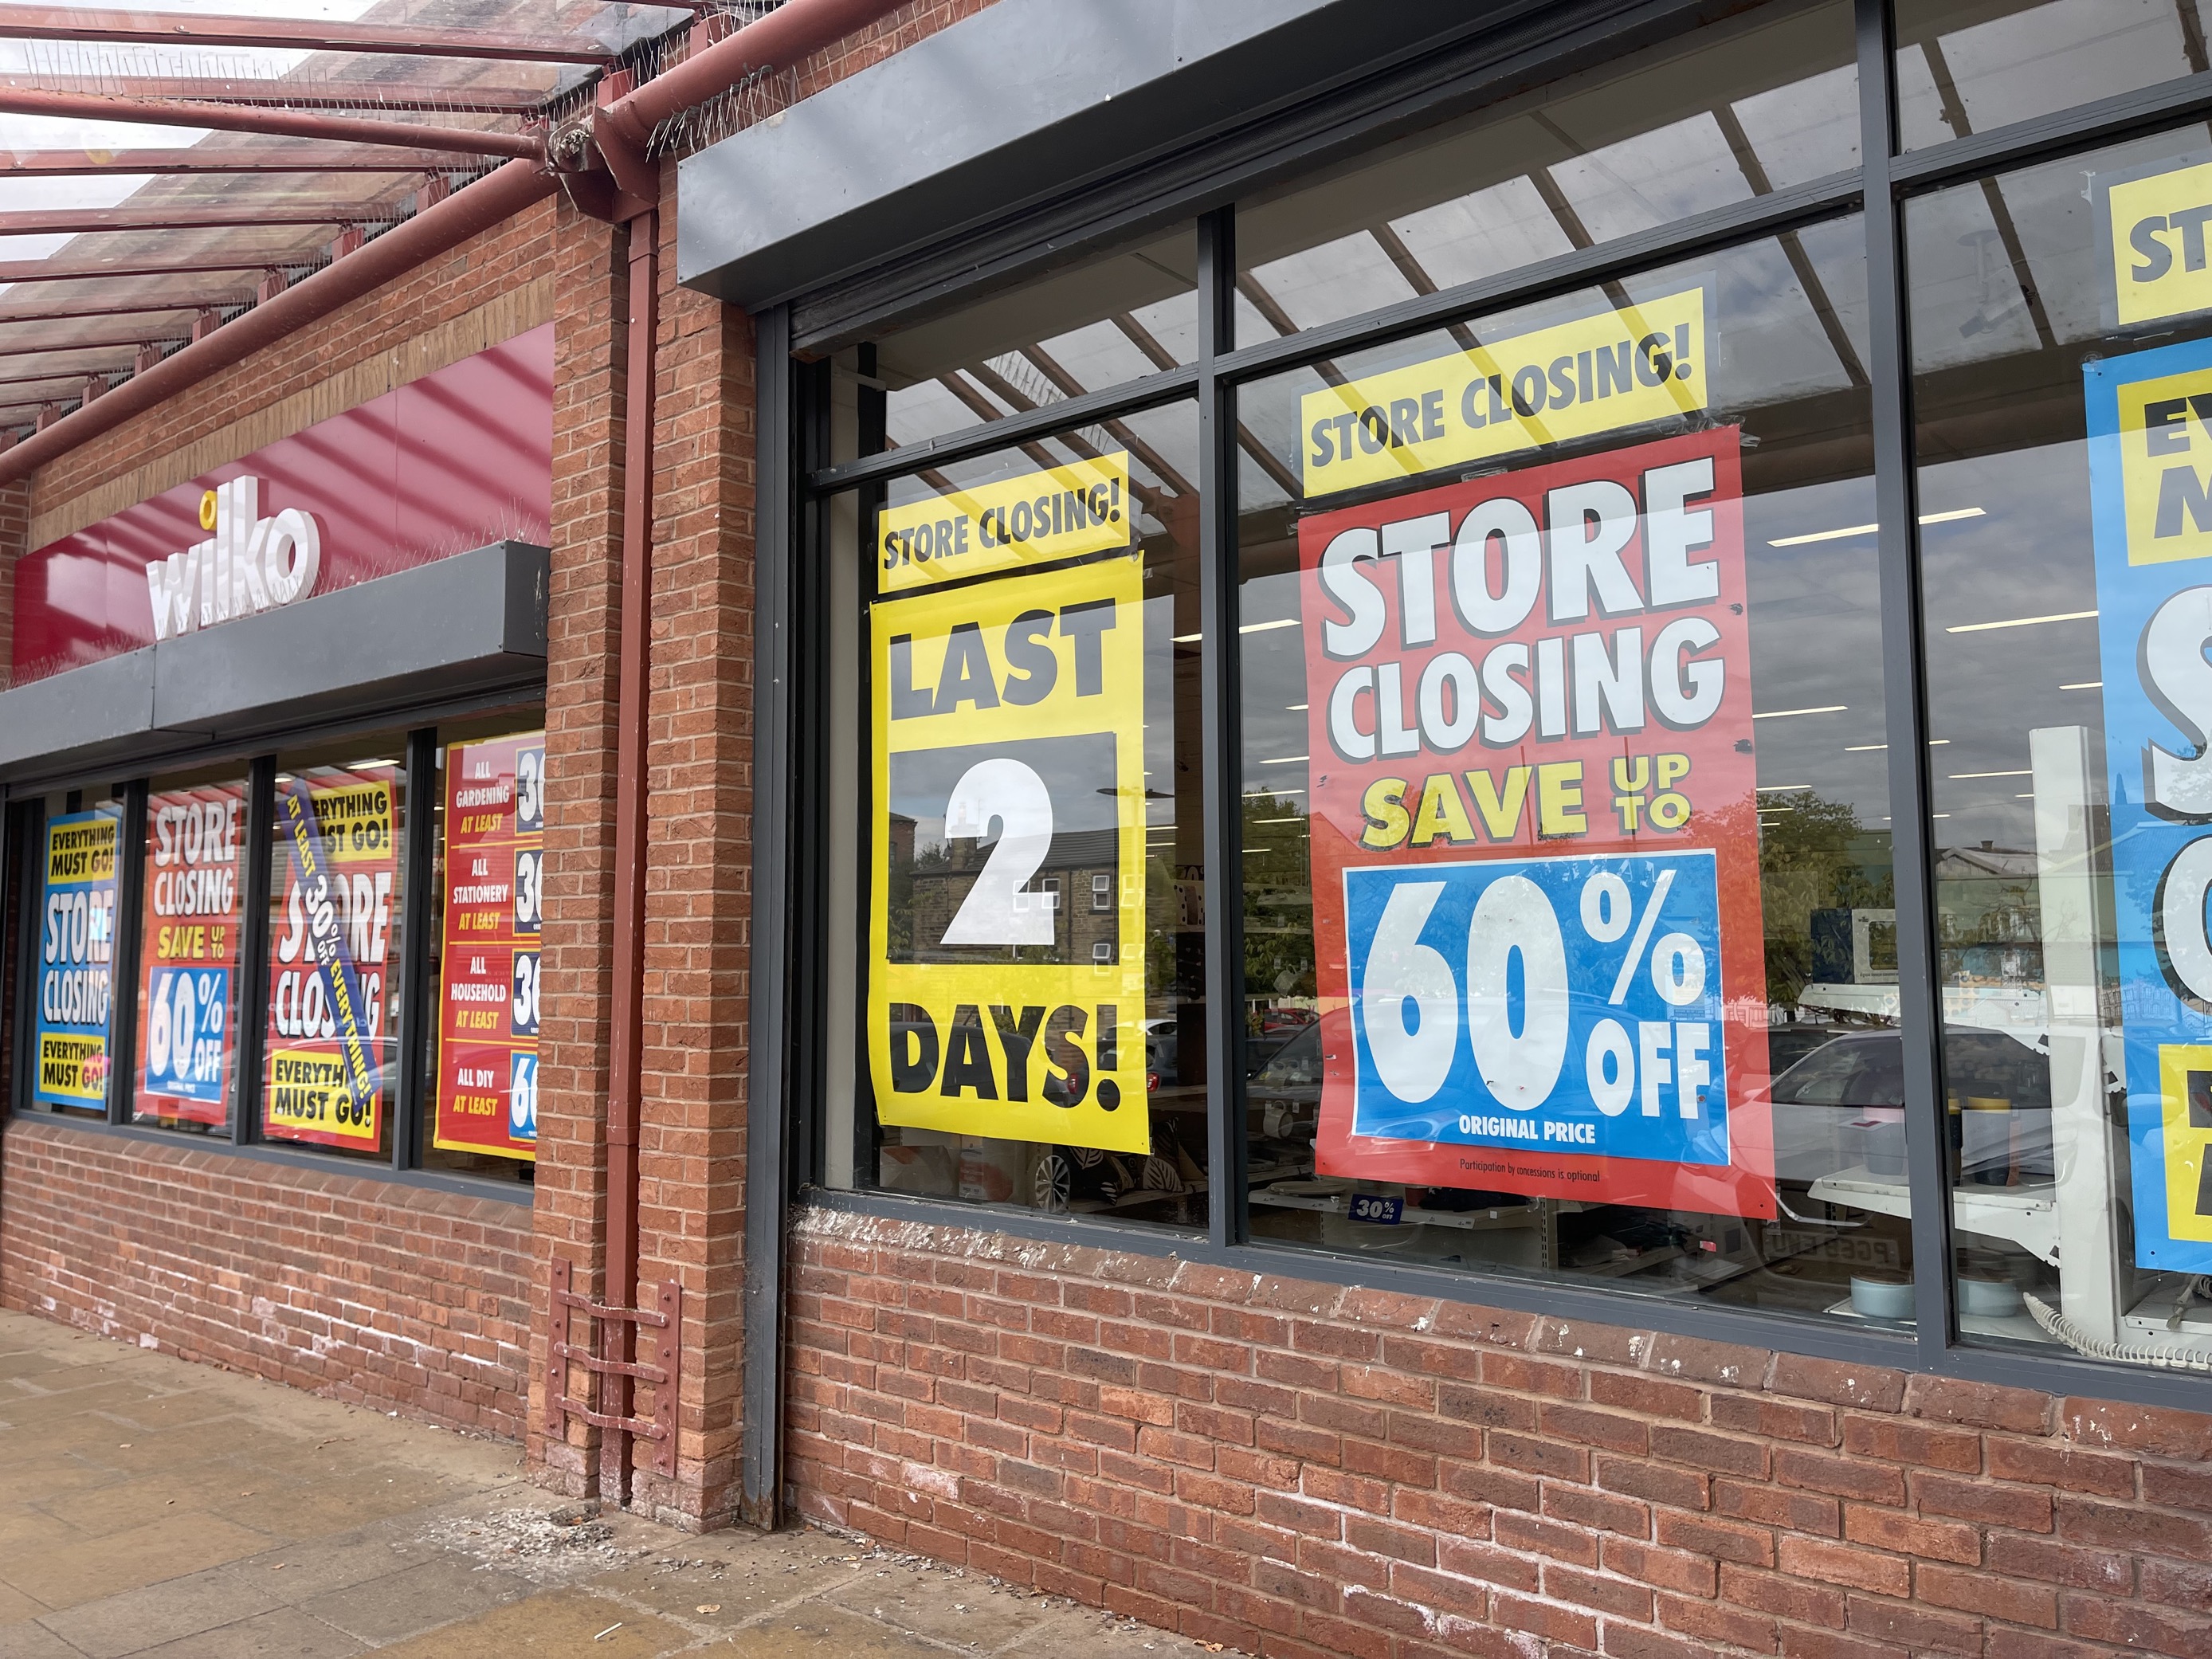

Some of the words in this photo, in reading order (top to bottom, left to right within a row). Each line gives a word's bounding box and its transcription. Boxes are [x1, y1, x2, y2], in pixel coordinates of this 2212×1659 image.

[1311, 388, 1445, 467] STORE
[1461, 323, 1692, 429] CLOSING!
[884, 514, 968, 570] STORE
[979, 477, 1121, 549] CLOSING!
[146, 476, 320, 641] wilko
[1319, 457, 1720, 658] STORE
[890, 598, 1116, 721] LAST
[1328, 617, 1725, 760] CLOSING
[475, 761, 491, 779] ALL
[1611, 753, 1691, 792] UP
[287, 794, 302, 820] AT
[309, 790, 387, 822] ERYTHING
[456, 785, 510, 808] GARDENING
[1361, 761, 1588, 849] SAVE
[1614, 793, 1691, 832] TO
[52, 826, 115, 851] EVERYTHING
[155, 798, 238, 867] STORE
[351, 818, 389, 852] GO!
[460, 816, 474, 834] AT
[474, 814, 504, 833] LEAST
[51, 852, 88, 877] MUST
[92, 847, 114, 874] GO!
[294, 819, 316, 877] LEAST
[939, 759, 1055, 945] 2
[471, 858, 488, 877] ALL
[154, 866, 234, 916] CLOSING
[453, 884, 508, 904] STATIONERY
[45, 889, 114, 965] STORE
[210, 925, 226, 942] UP
[278, 871, 392, 963] SORE
[458, 913, 470, 931] AT
[472, 912, 501, 931] LEAST
[158, 925, 206, 959] SAVE
[210, 943, 225, 960] TO
[317, 940, 331, 967] OFF
[469, 956, 487, 975] ALL
[43, 969, 108, 1026] CLOSING
[450, 982, 507, 1002] HOUSEHOLD
[1363, 869, 1706, 1112] 60%
[150, 972, 223, 1081] 60%
[330, 958, 372, 1100] EVERYTHING!
[455, 1010, 469, 1028] AT
[469, 1010, 499, 1030] LEAST
[43, 1041, 104, 1063] EVERYTHING
[194, 1037, 222, 1082] OFF
[889, 1002, 1121, 1112] DAYS!
[43, 1062, 78, 1088] MUST
[81, 1065, 104, 1092] GO!
[276, 1059, 351, 1088] EVERYTH
[457, 1068, 474, 1087] ALL
[477, 1069, 495, 1088] DIY
[1586, 1018, 1710, 1120] OFF
[274, 1087, 328, 1120] MUST
[453, 1095, 467, 1113] AT
[468, 1096, 498, 1116] LEAST
[1459, 1115, 1539, 1139] ORIGINAL
[1543, 1121, 1596, 1143] PRICE
[1460, 1158, 1506, 1174] Participation
[1508, 1163, 1516, 1176] by
[1517, 1167, 1555, 1179] concessions
[1558, 1169, 1564, 1179] is
[1567, 1171, 1600, 1182] optional
[1356, 1199, 1394, 1218] 30%
